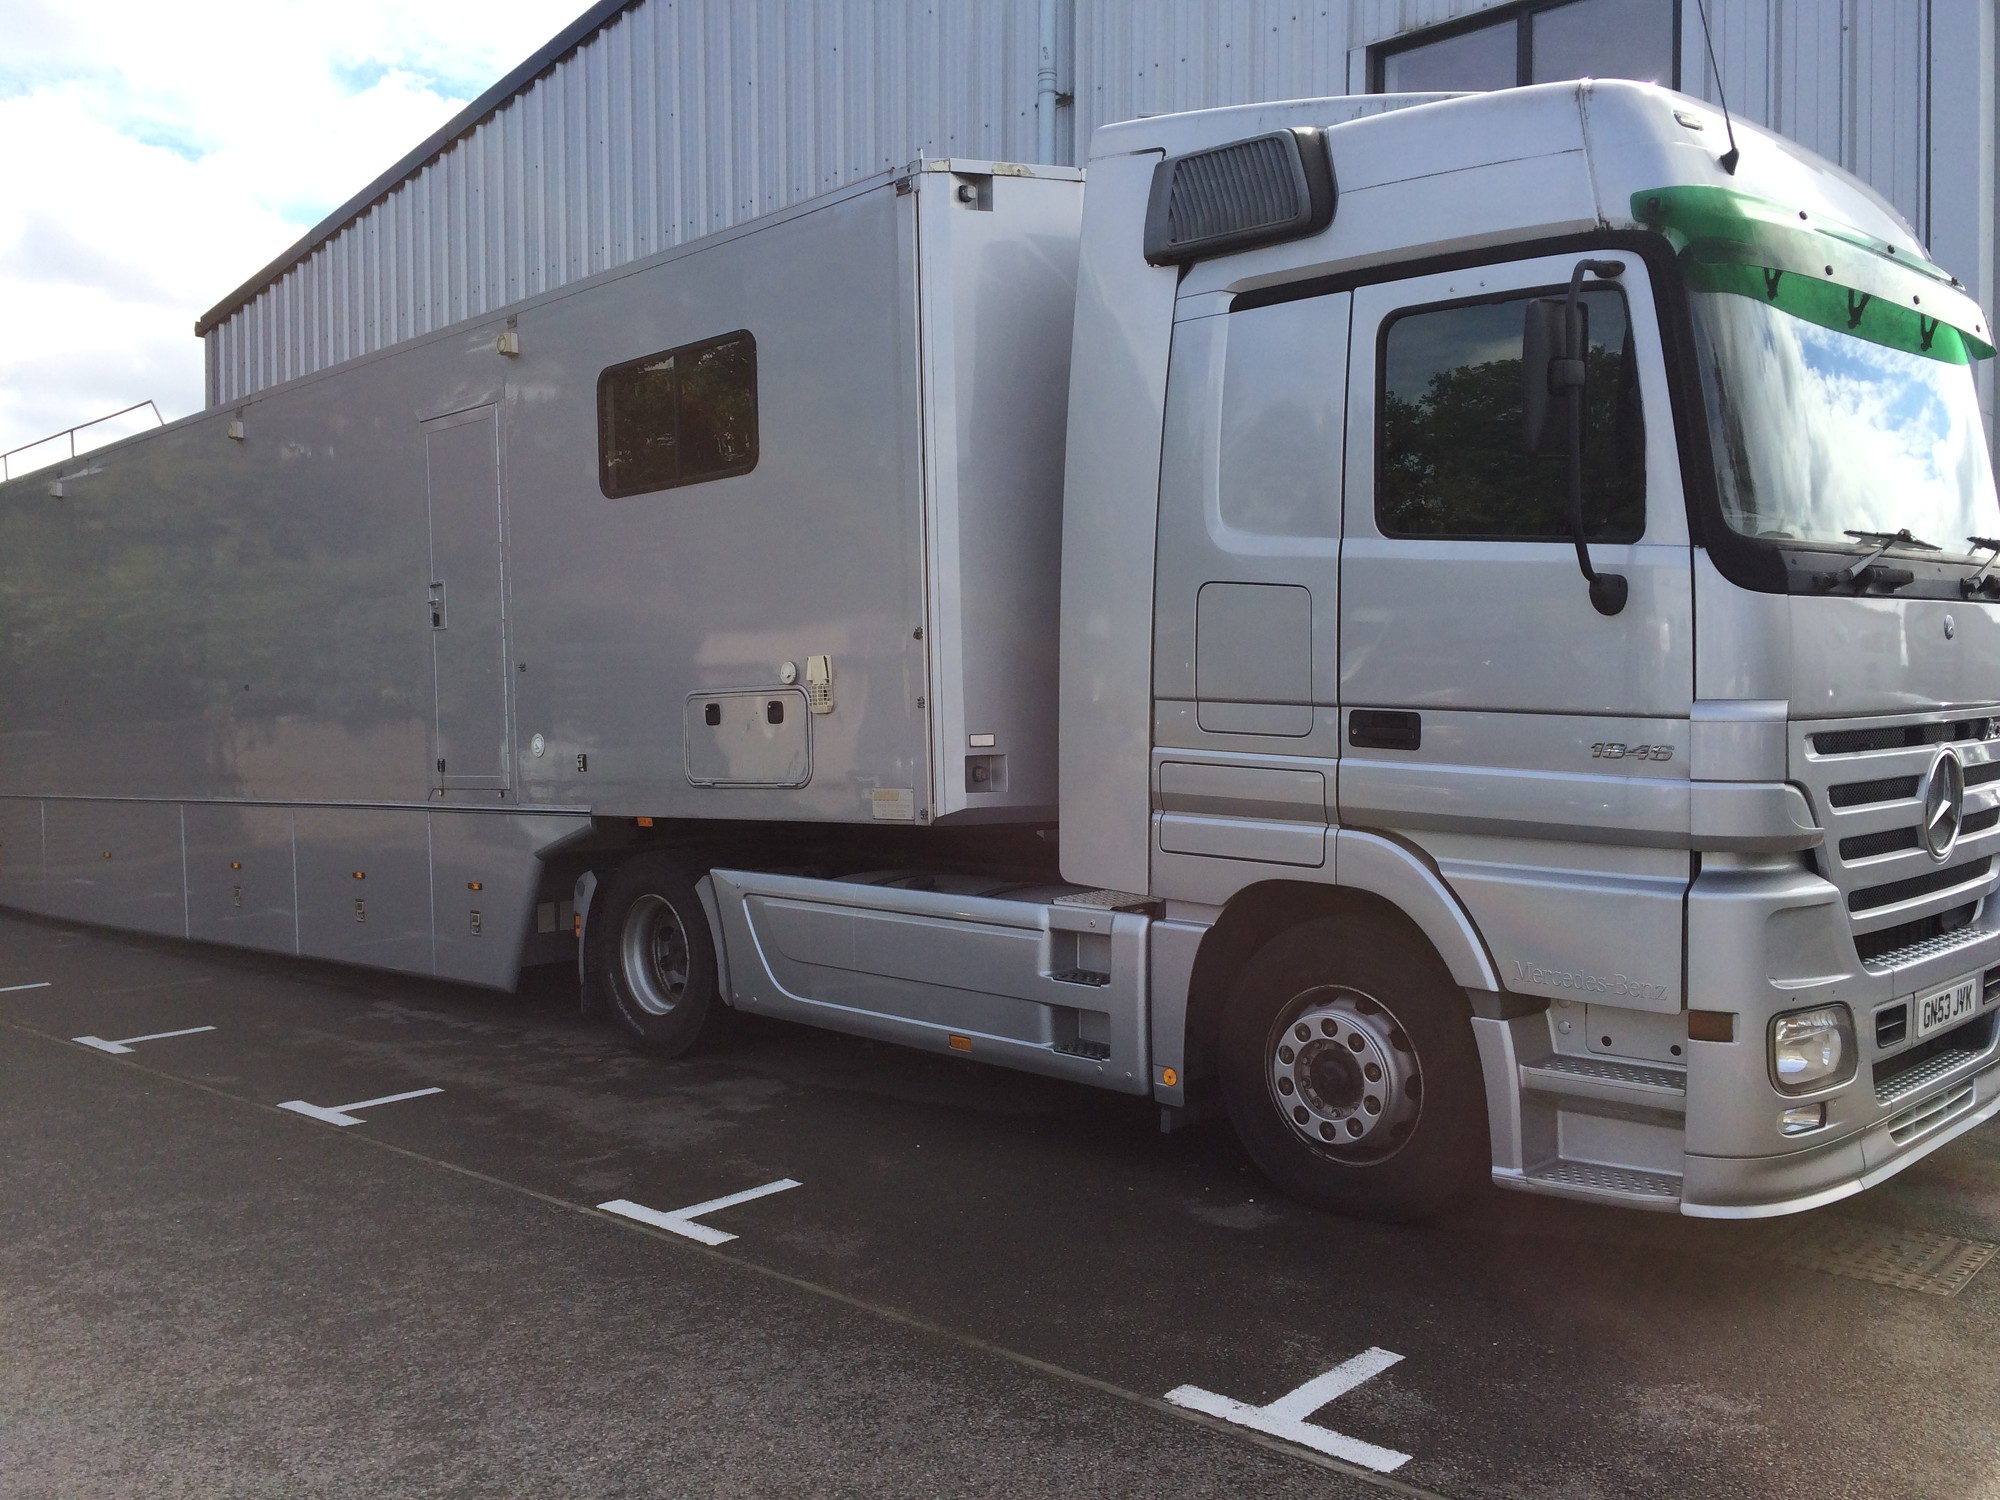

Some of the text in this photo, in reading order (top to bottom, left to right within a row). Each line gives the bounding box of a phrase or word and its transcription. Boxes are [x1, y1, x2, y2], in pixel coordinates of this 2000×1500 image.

[1590, 743, 1675, 761] 1846
[1512, 960, 1668, 1001] Mercedes-Benz
[1923, 993, 1951, 1028] GN53
